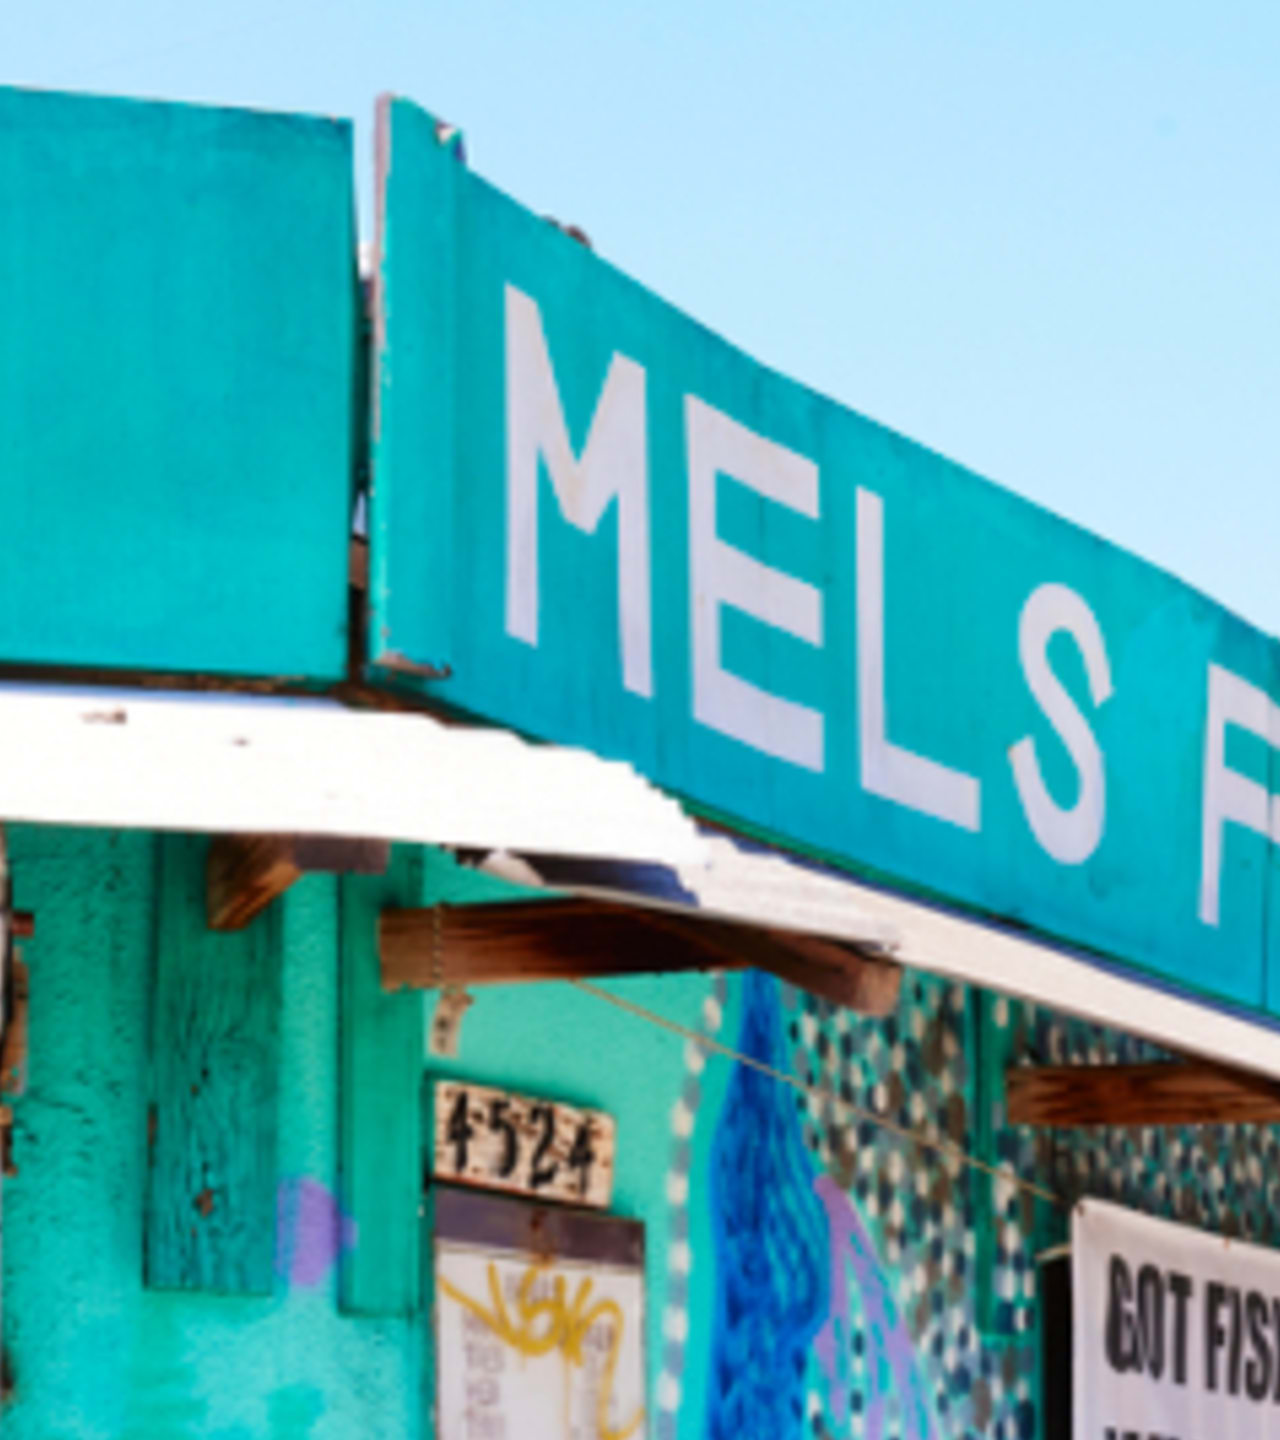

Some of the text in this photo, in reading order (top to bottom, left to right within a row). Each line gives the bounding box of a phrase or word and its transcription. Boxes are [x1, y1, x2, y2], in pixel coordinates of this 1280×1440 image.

[504, 281, 1115, 865] MELS
[447, 1090, 595, 1196] 4524
[1106, 1253, 1192, 1387] GOT
